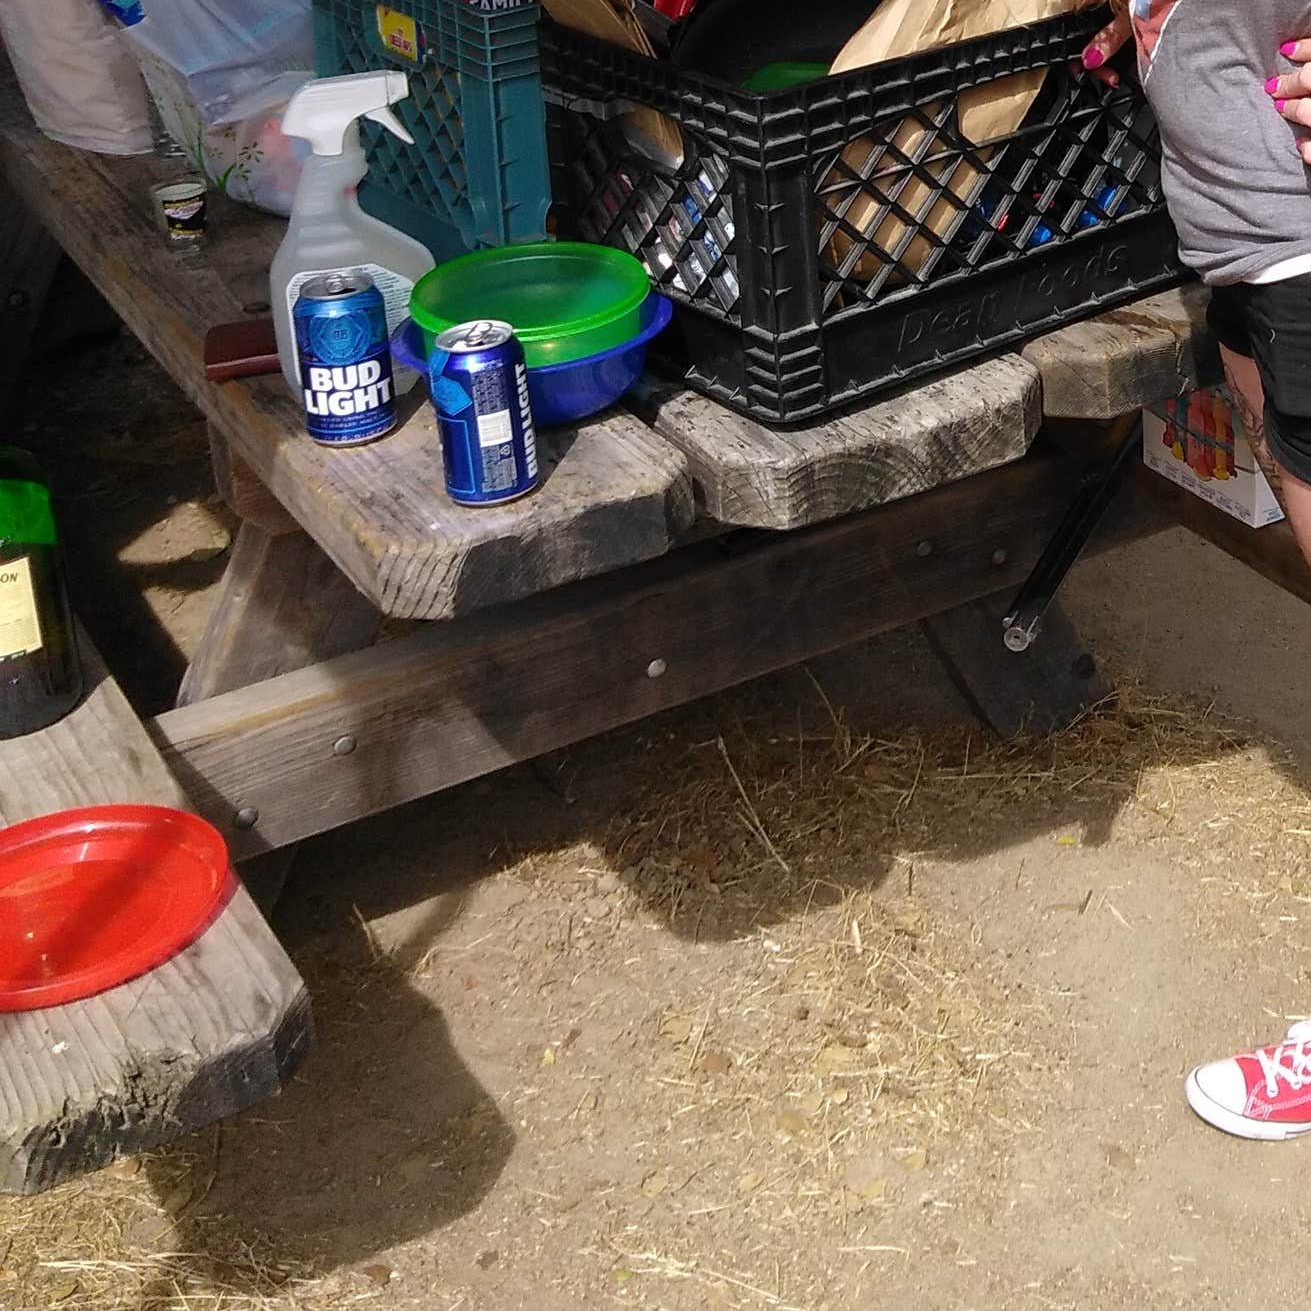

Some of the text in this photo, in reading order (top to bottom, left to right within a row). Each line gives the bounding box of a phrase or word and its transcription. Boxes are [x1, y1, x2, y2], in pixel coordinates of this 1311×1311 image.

[304, 376, 392, 416] LIGHT
[309, 360, 381, 392] BUD
[514, 363, 539, 479] BUD LIGHT
